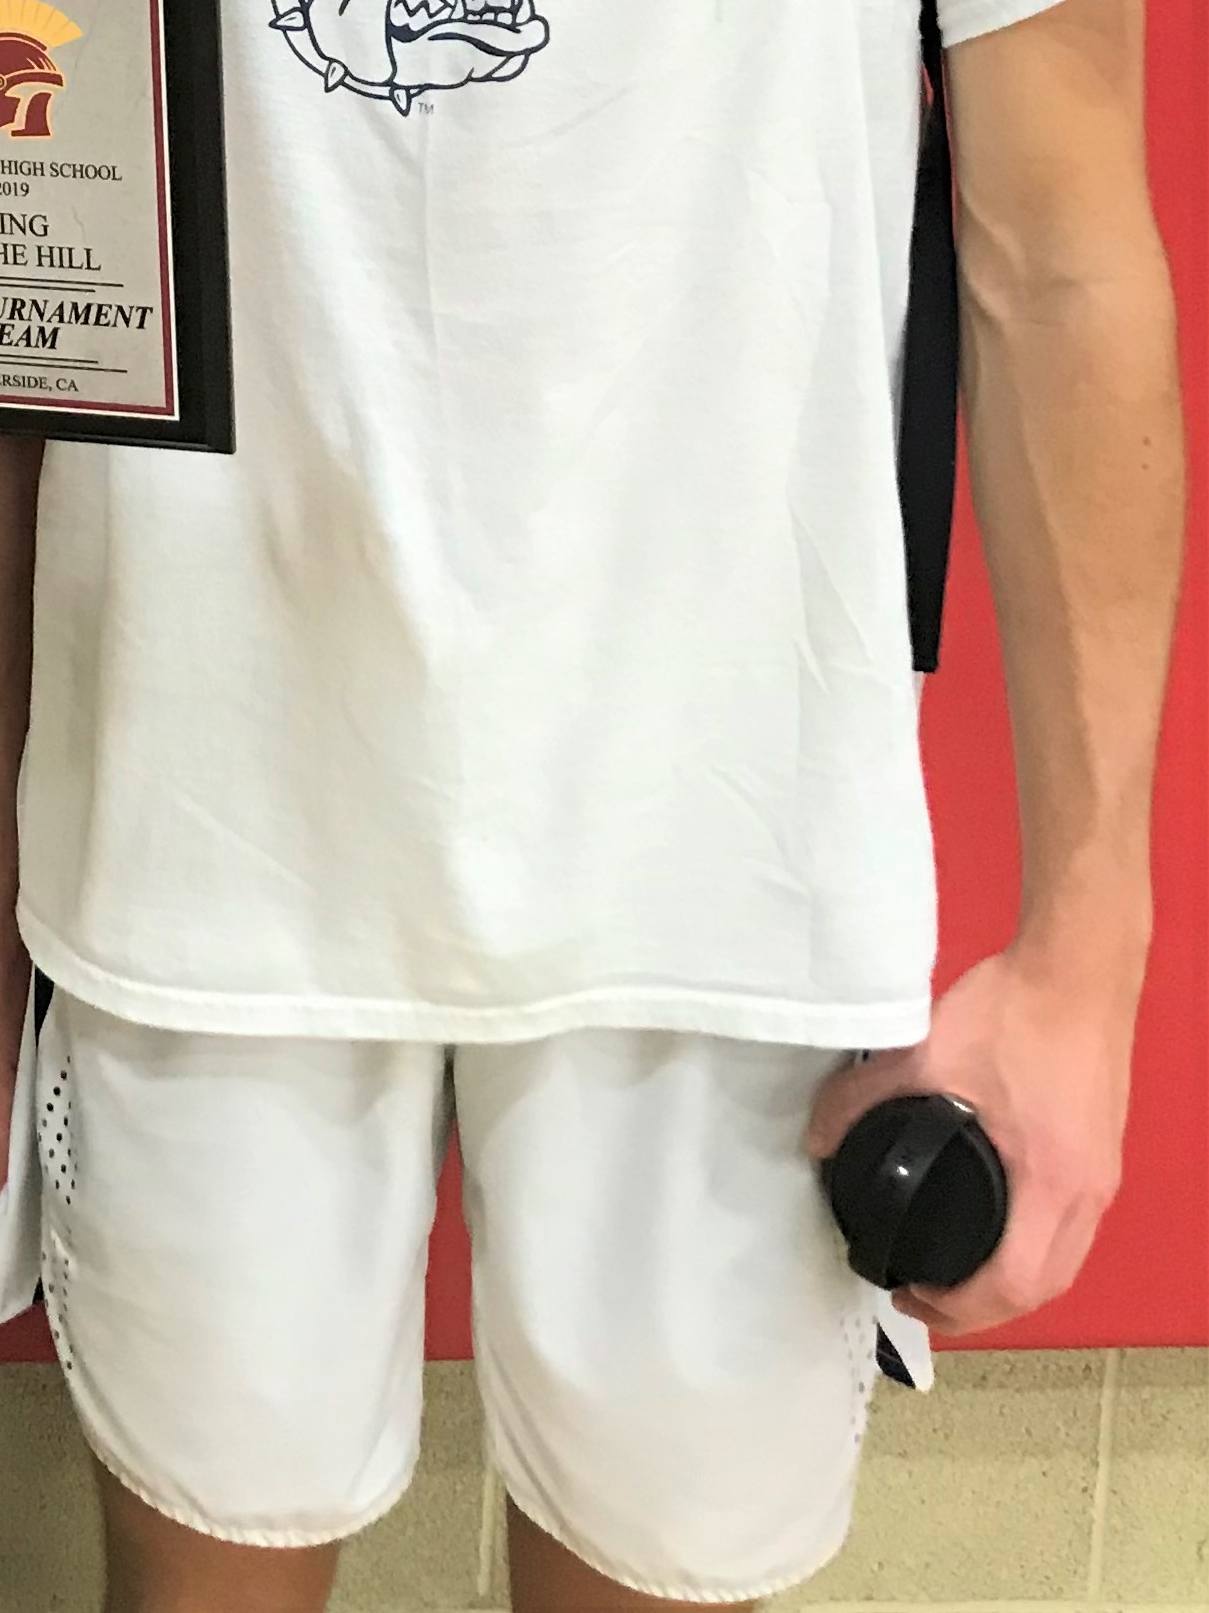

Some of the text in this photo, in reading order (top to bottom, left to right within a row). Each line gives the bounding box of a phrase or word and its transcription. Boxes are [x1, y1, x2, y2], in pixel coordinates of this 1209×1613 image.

[0, 160, 46, 178] HIGH
[49, 162, 123, 182] SCHOOL
[35, 244, 103, 272] HILL
[55, 377, 80, 393] CA
